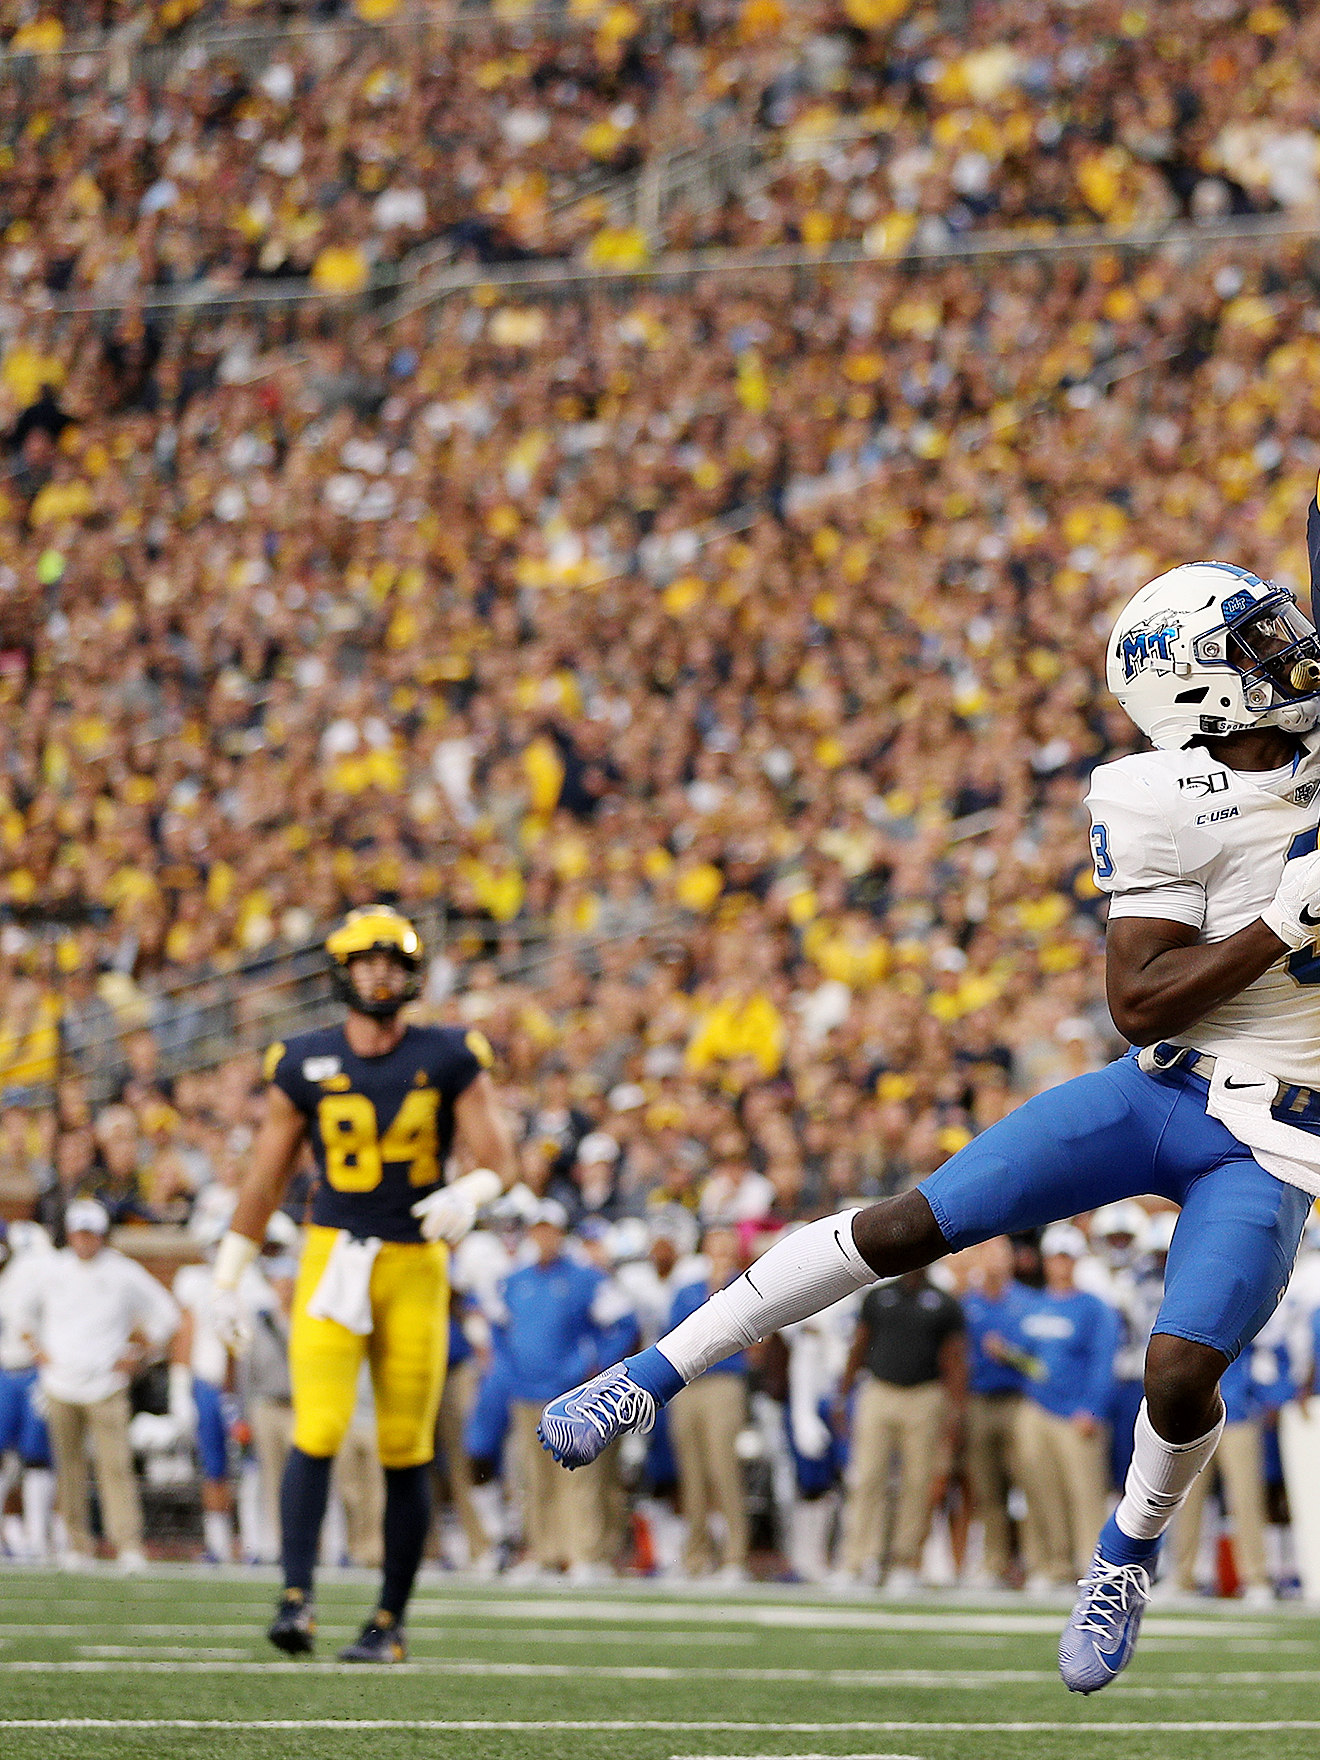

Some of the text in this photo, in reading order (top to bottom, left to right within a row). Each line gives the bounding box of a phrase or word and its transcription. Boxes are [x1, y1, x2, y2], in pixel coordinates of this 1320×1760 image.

[1176, 771, 1230, 798] 150
[1091, 823, 1116, 879] 3
[318, 1088, 442, 1193] 84
